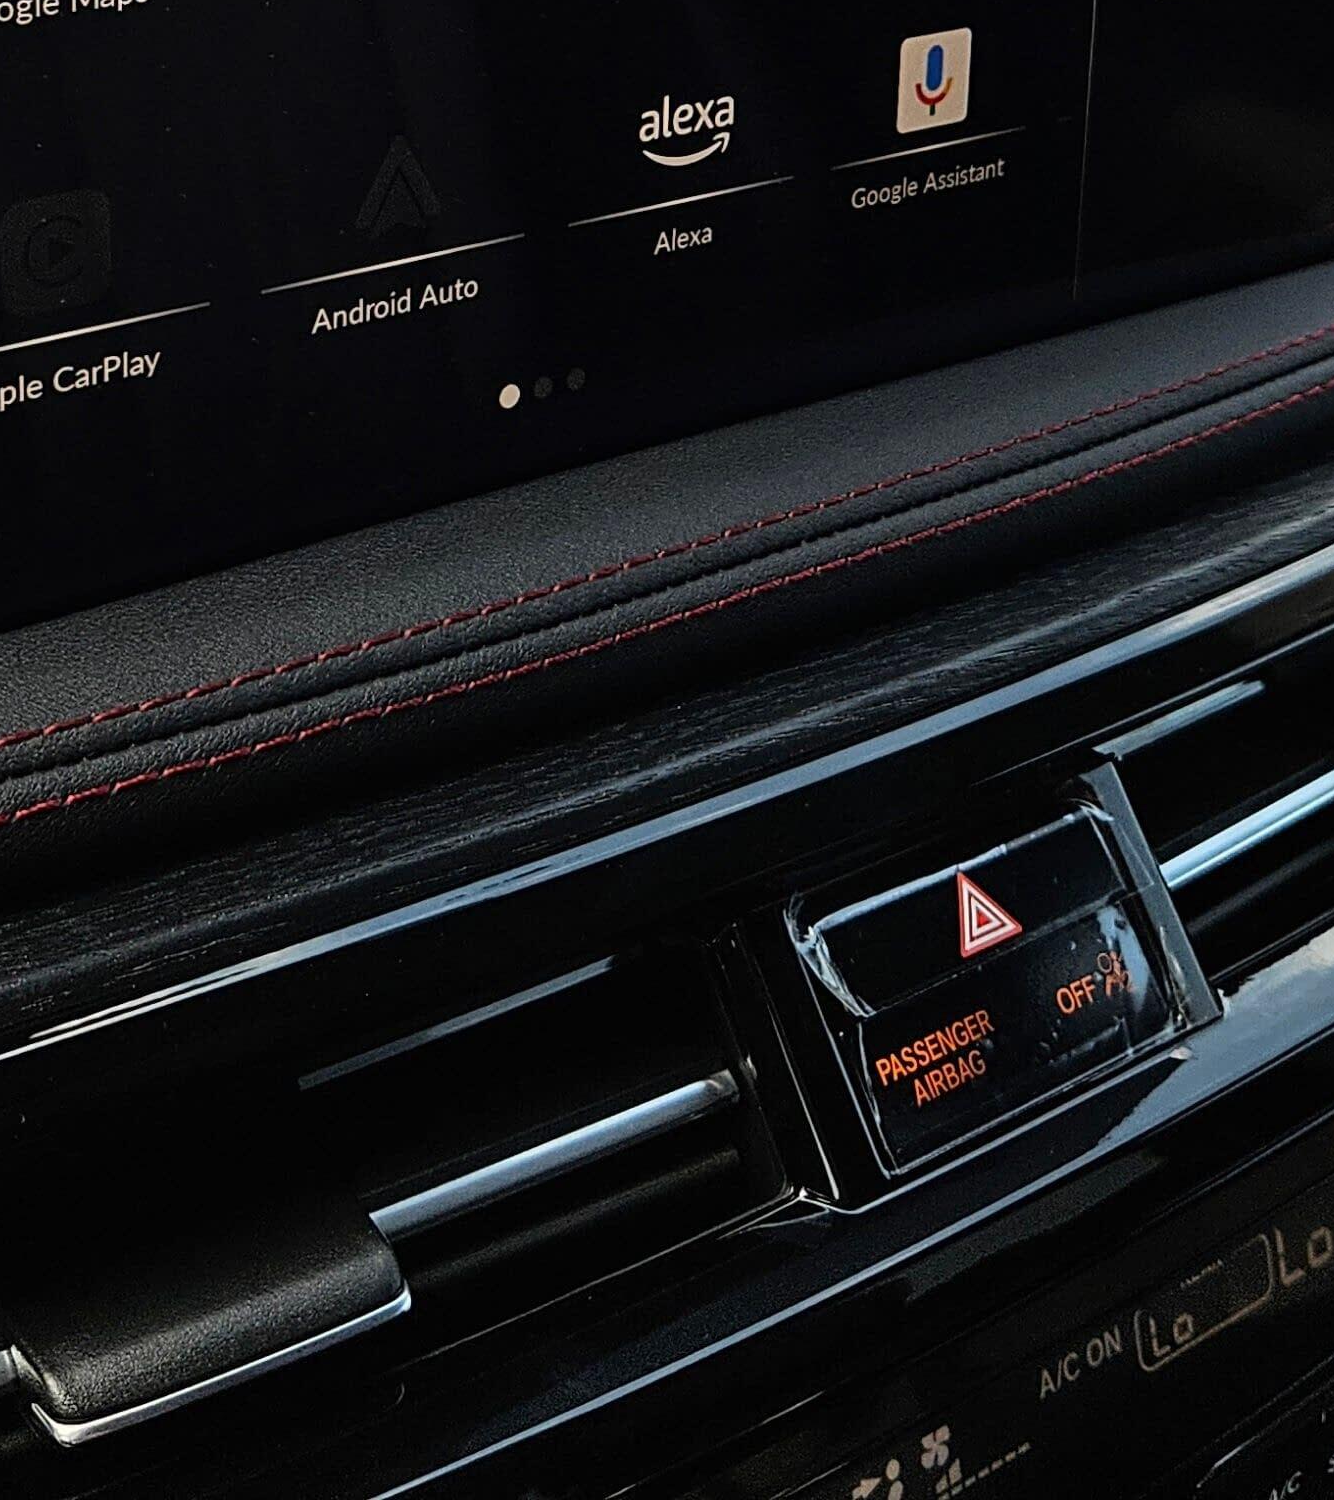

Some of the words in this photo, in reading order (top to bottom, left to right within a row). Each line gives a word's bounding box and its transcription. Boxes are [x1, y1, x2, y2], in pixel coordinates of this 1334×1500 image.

[638, 94, 735, 143] alexa
[851, 176, 919, 209] Google
[922, 159, 1005, 194] Assistant
[653, 226, 713, 256] Alexa
[311, 289, 413, 335] Android
[418, 278, 479, 310] Auto
[52, 351, 161, 393] CarPlay
[1056, 975, 1096, 1014] OFF
[875, 1010, 995, 1087] PASSENGER
[912, 1050, 987, 1107] AIRBAG
[1039, 1350, 1081, 1400] A/C
[1085, 1324, 1123, 1368] ON
